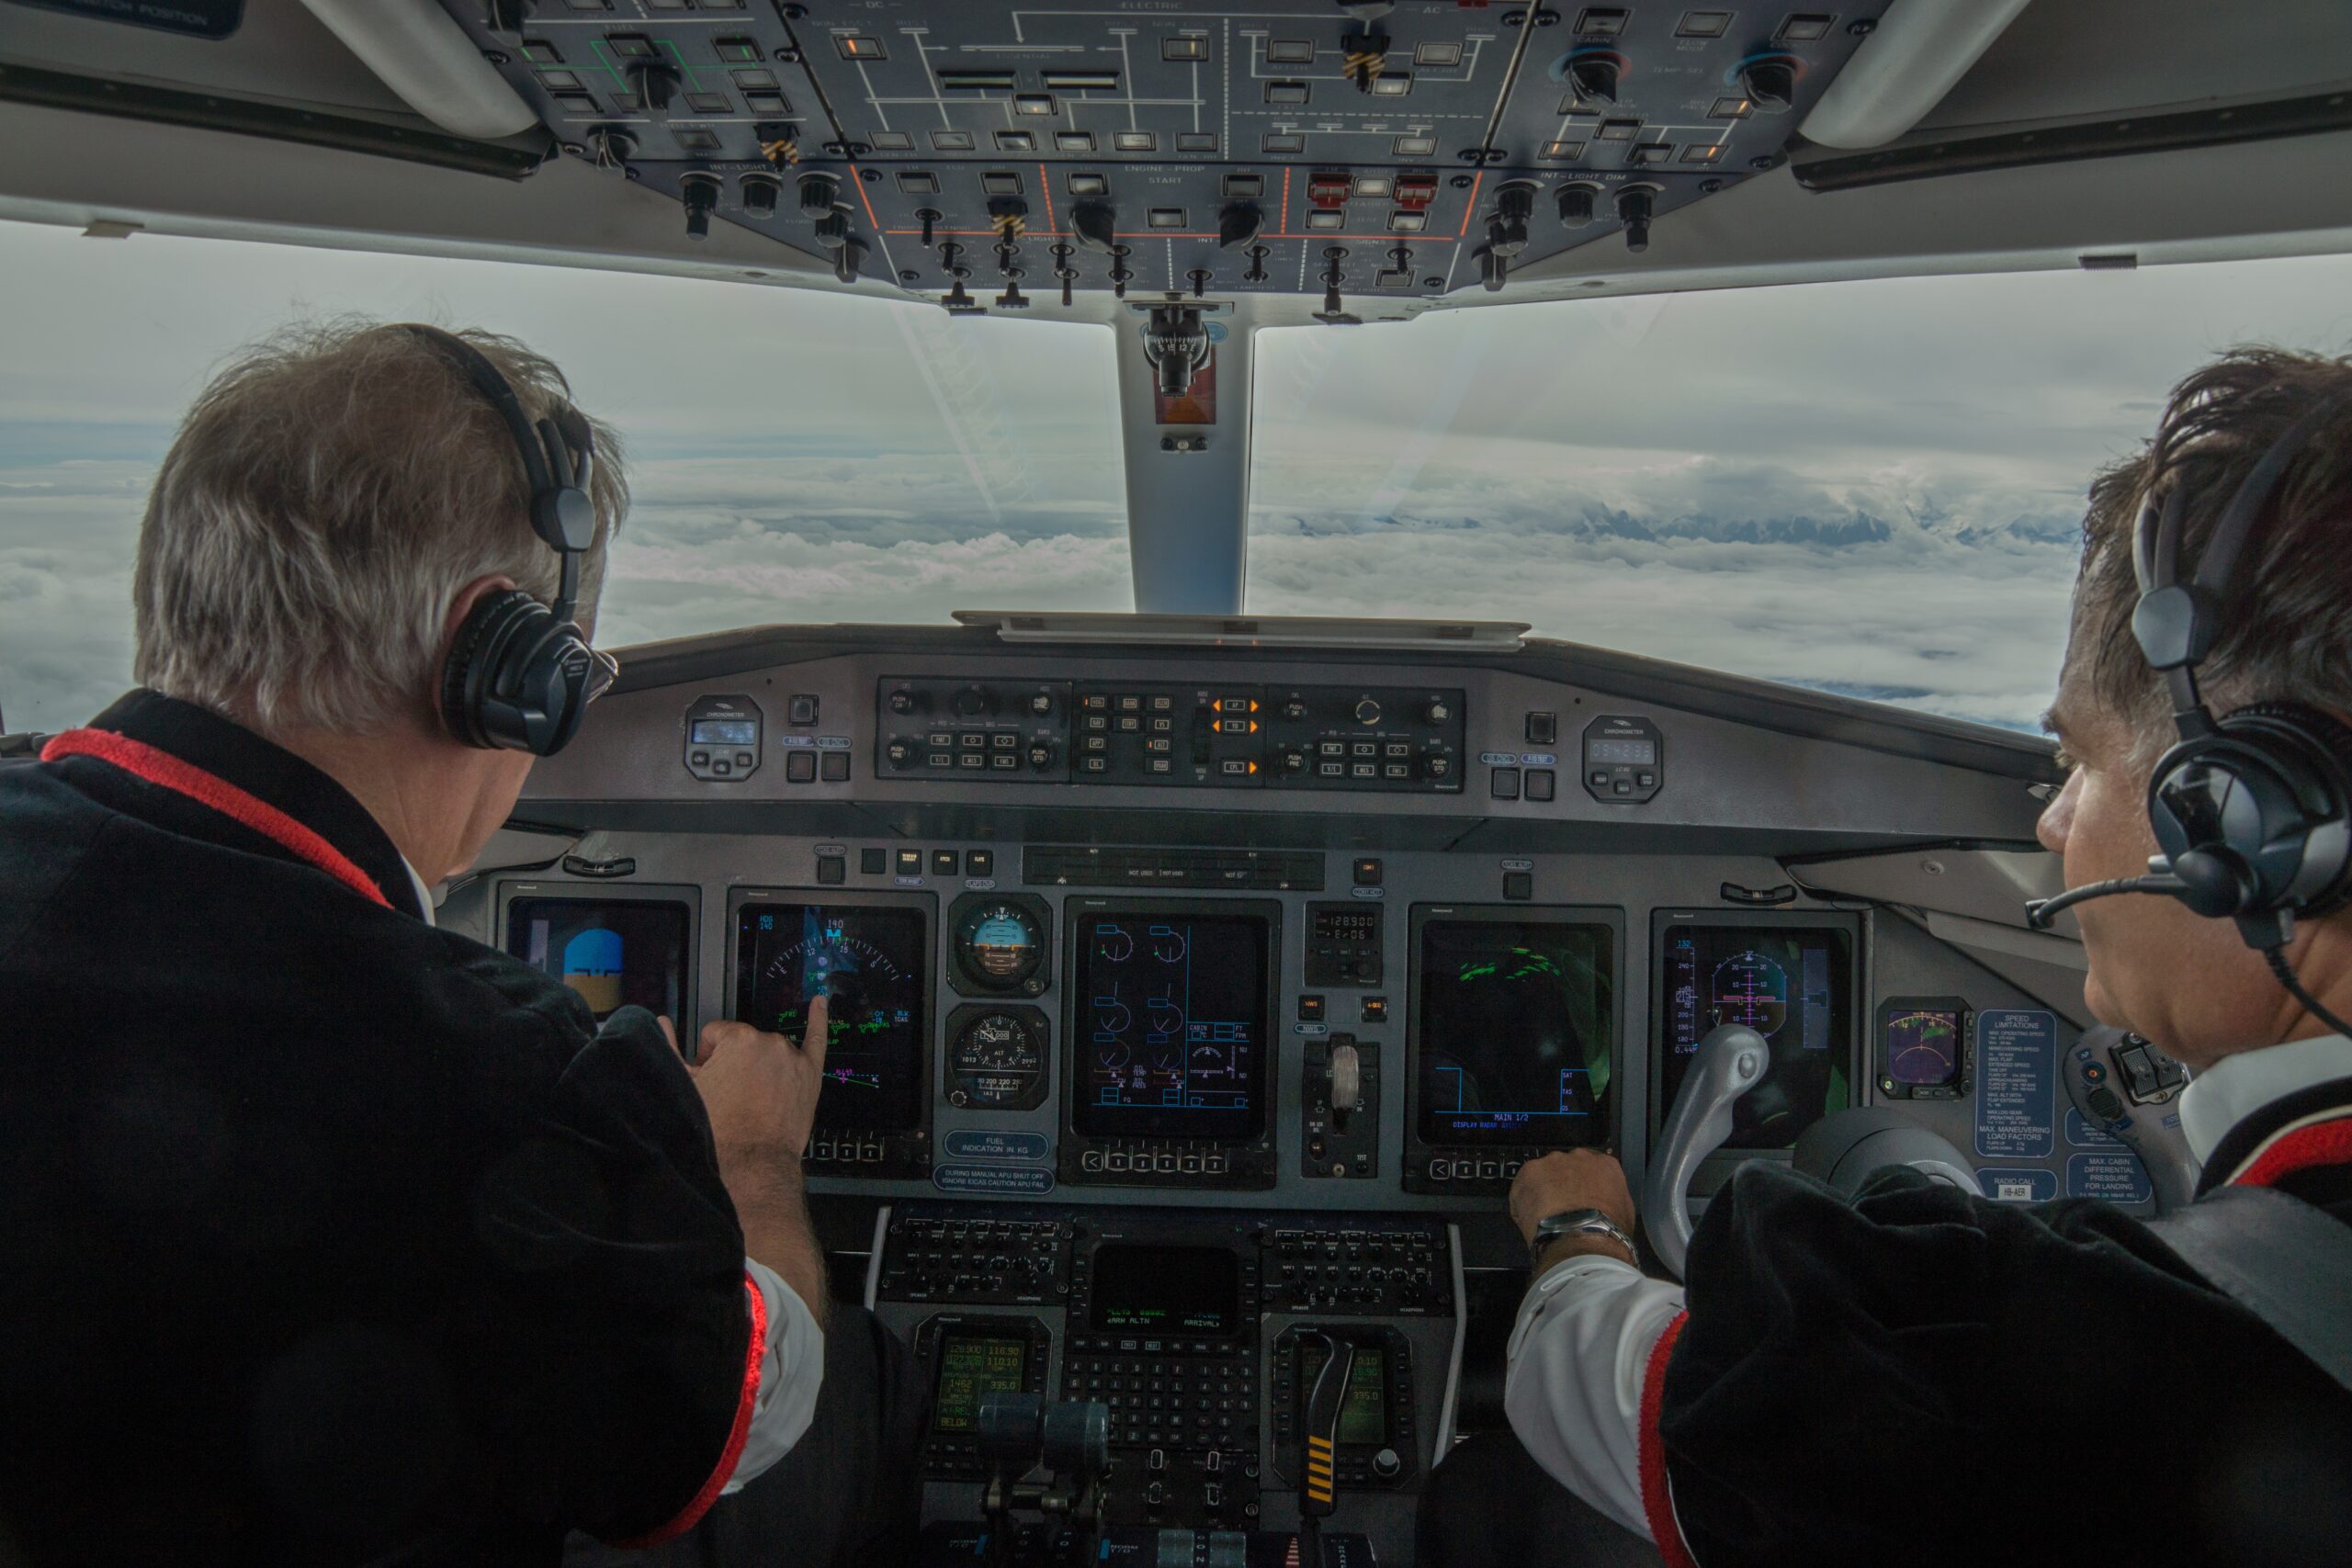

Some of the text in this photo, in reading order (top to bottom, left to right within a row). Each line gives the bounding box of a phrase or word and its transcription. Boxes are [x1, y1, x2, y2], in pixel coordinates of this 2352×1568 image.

[1122, 2, 1182, 10] ELECTRIC
[139, 4, 209, 26] POSITION
[1540, 172, 1627, 181] INT-LIGHT DIM
[1167, 344, 1176, 352] 15
[1179, 344, 1187, 352] 12
[760, 922, 774, 931] 140
[827, 919, 844, 929] 140
[807, 947, 816, 956] 12
[840, 945, 849, 953] 15
[1995, 1021, 2040, 1030] LIMITATIONS
[1494, 1113, 1529, 1122] MAIN 1/2
[1997, 1125, 2051, 1134] MANEUVERING
[986, 1137, 1004, 1145] FUEL
[962, 1145, 1003, 1154] INDICATION
[944, 1169, 970, 1178] DURING
[971, 1170, 998, 1179] MANUAL
[2084, 1166, 2134, 1174] DIFFERENTIAL
[2004, 1188, 2026, 1196] HB-AER
[989, 1346, 1019, 1356] 116.90
[987, 1357, 1018, 1367] 110.10
[990, 1381, 1016, 1390] 335.0
[941, 1416, 967, 1427] BELOW
